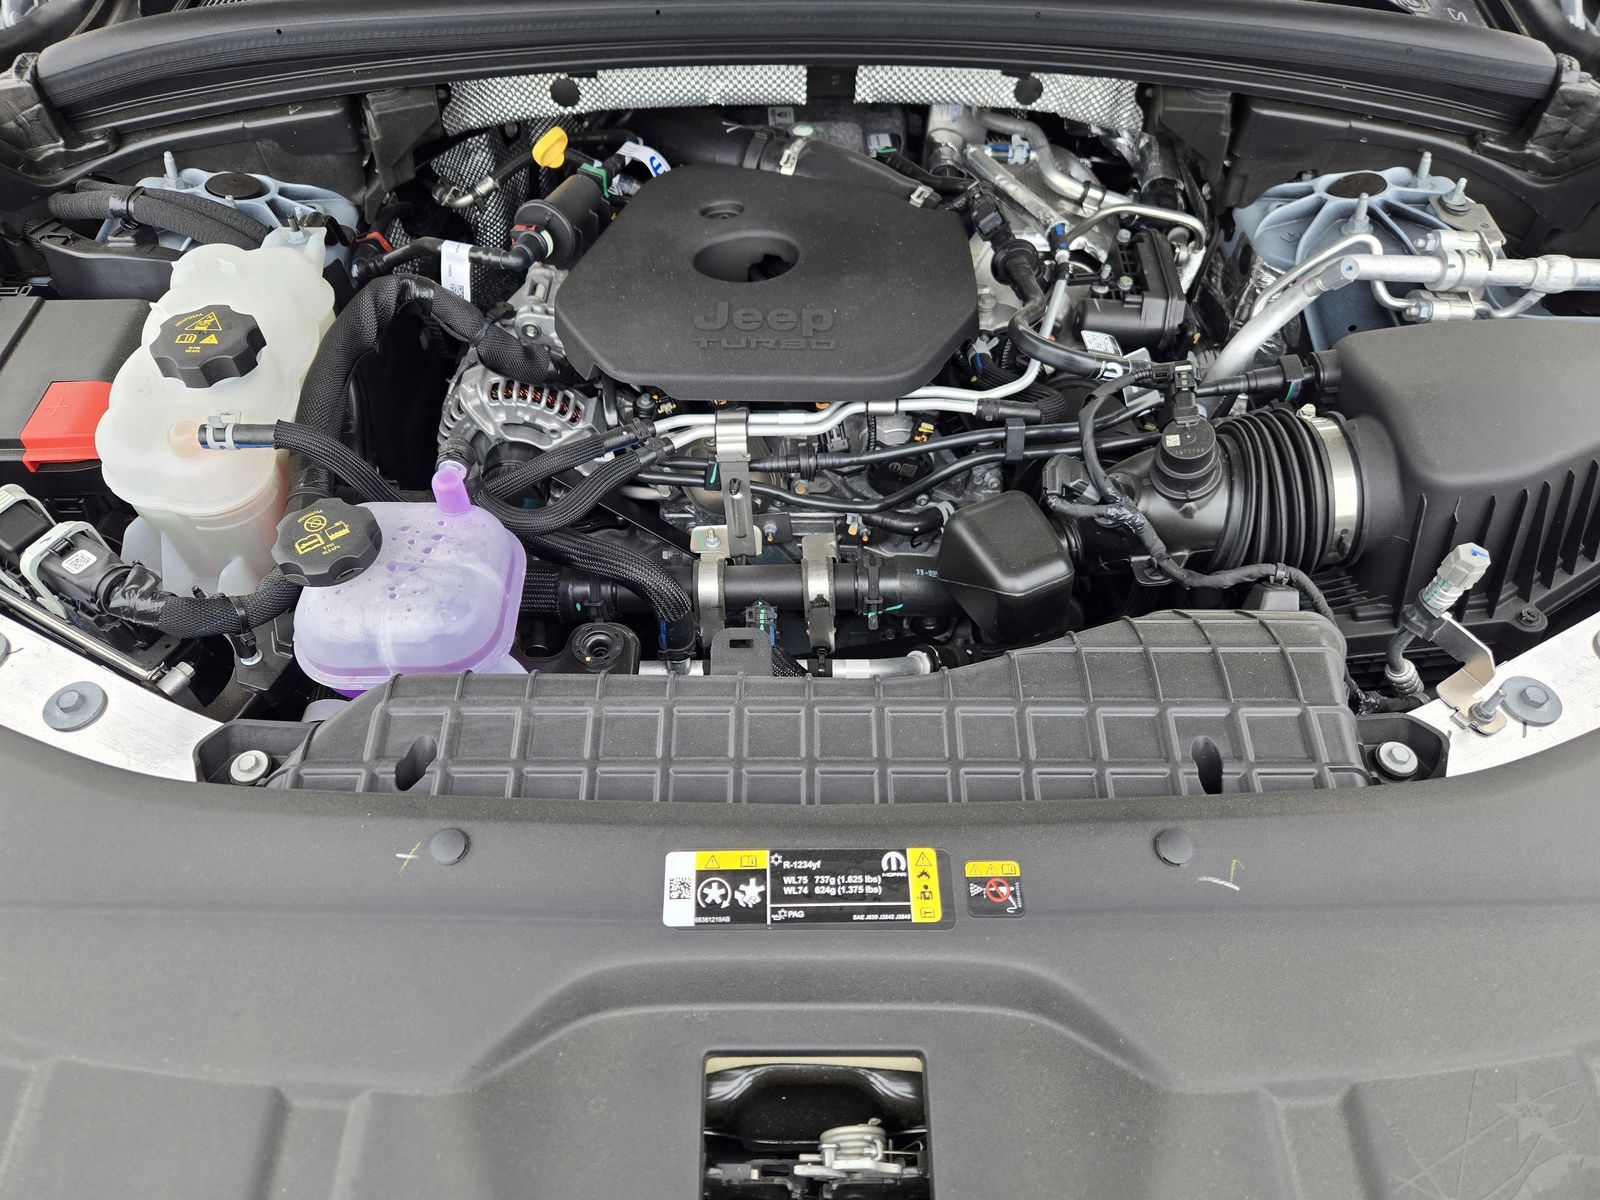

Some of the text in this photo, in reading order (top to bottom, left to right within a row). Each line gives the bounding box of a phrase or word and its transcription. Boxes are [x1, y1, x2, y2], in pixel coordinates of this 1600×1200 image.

[692, 301, 835, 337] Jeep
[689, 338, 836, 350] TURBO
[783, 860, 821, 870] R-1234yf
[783, 875, 882, 885] WL75 737g (1.625 lbs)
[783, 885, 882, 895] WL74 624g (1.375 lbs)
